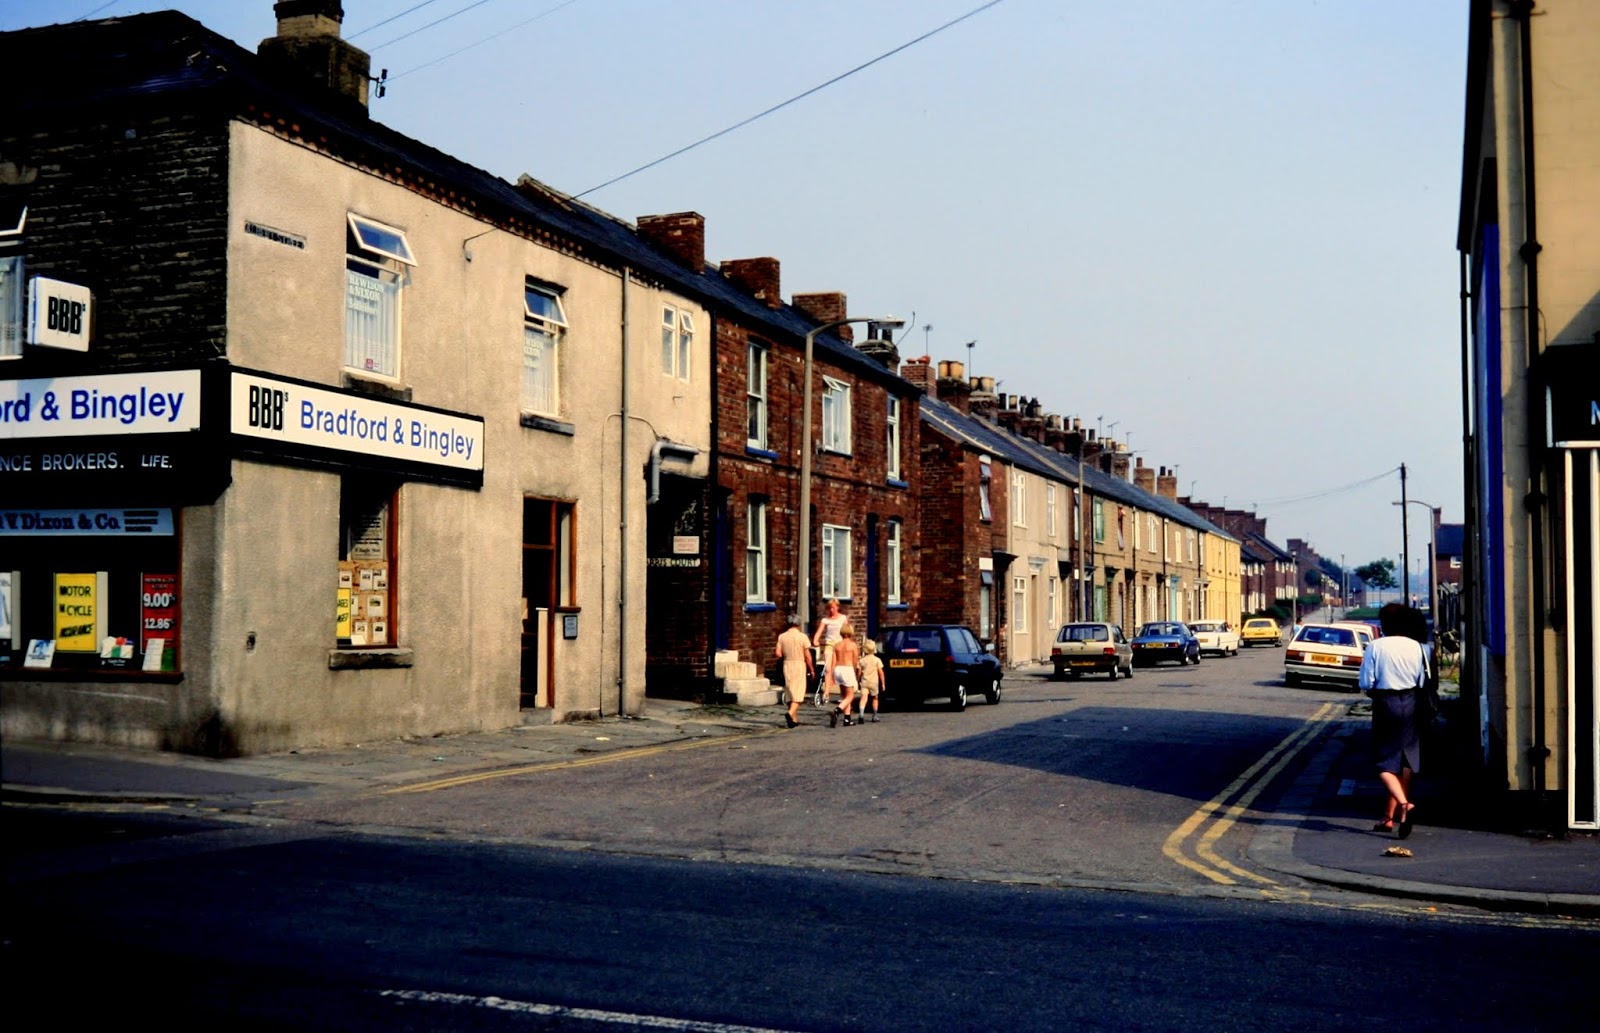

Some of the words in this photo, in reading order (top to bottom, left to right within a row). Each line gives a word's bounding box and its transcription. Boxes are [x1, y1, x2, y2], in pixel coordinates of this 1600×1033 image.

[0, 392, 31, 423] rd
[41, 391, 60, 421] &
[71, 386, 185, 424] Bingley
[300, 400, 388, 442] Bradford
[393, 418, 405, 445] &
[410, 420, 474, 461] Bingley
[42, 452, 124, 471] BROKERS.
[141, 454, 173, 469] LIFE.
[21, 511, 75, 530] Dixon
[78, 512, 93, 530] &
[670, 558, 697, 567] COURT
[59, 585, 91, 597] MOTOR
